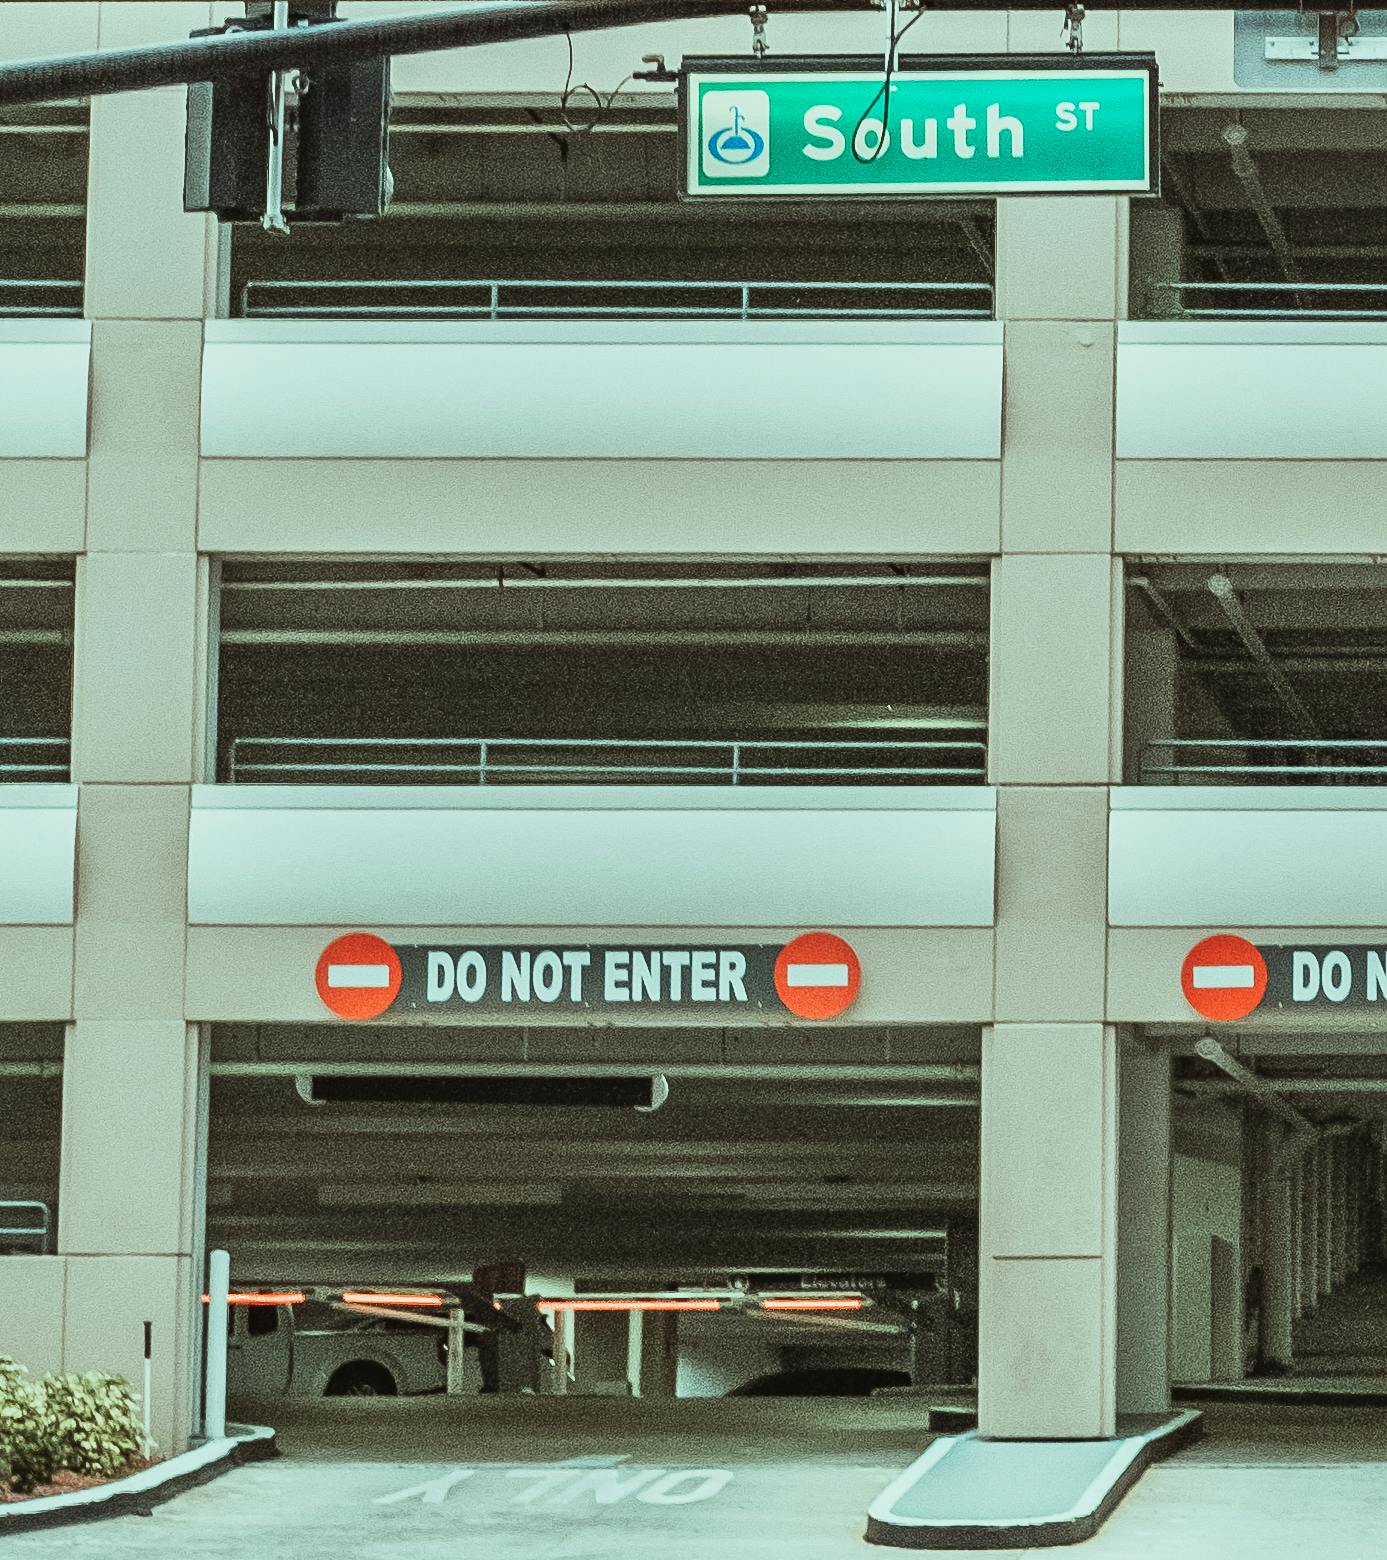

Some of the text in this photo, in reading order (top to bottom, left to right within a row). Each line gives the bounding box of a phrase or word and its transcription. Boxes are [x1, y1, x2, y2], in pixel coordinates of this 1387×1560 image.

[802, 101, 1100, 161] South ST
[426, 950, 748, 1003] DO NOT ENTER
[1292, 950, 1352, 1002] DO
